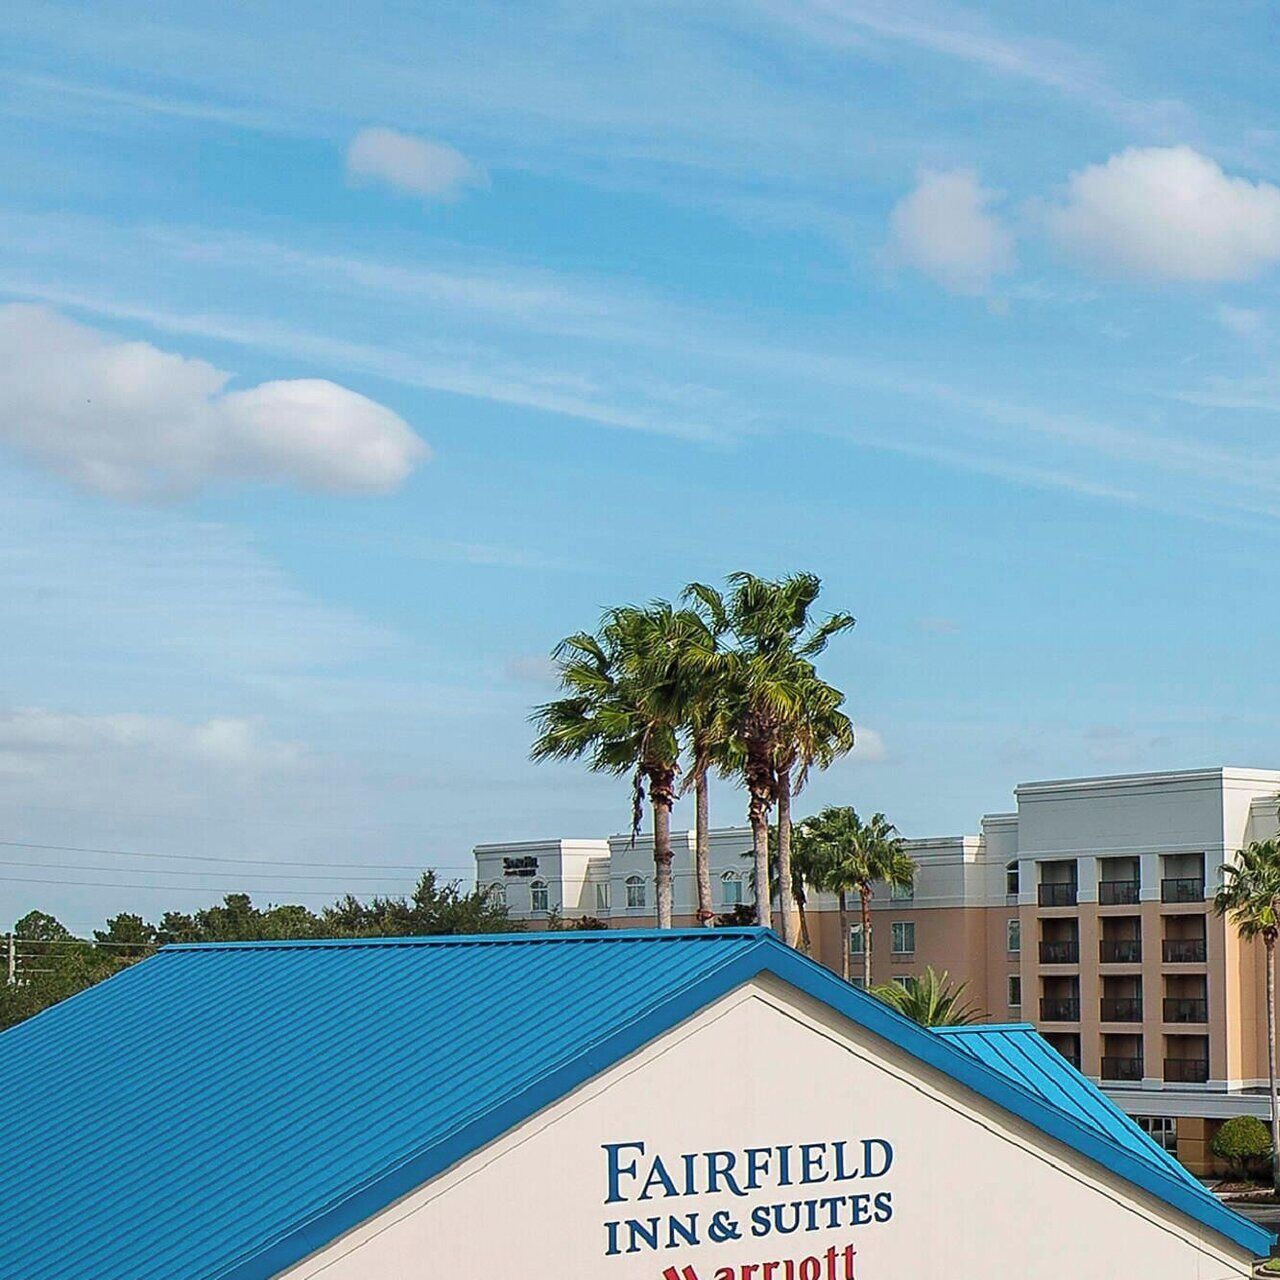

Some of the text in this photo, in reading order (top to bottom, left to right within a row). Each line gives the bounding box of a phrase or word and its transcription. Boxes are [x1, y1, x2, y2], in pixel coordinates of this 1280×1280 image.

[601, 1138, 894, 1205] FAIRFIELD
[604, 1192, 893, 1256] INN & SUITES
